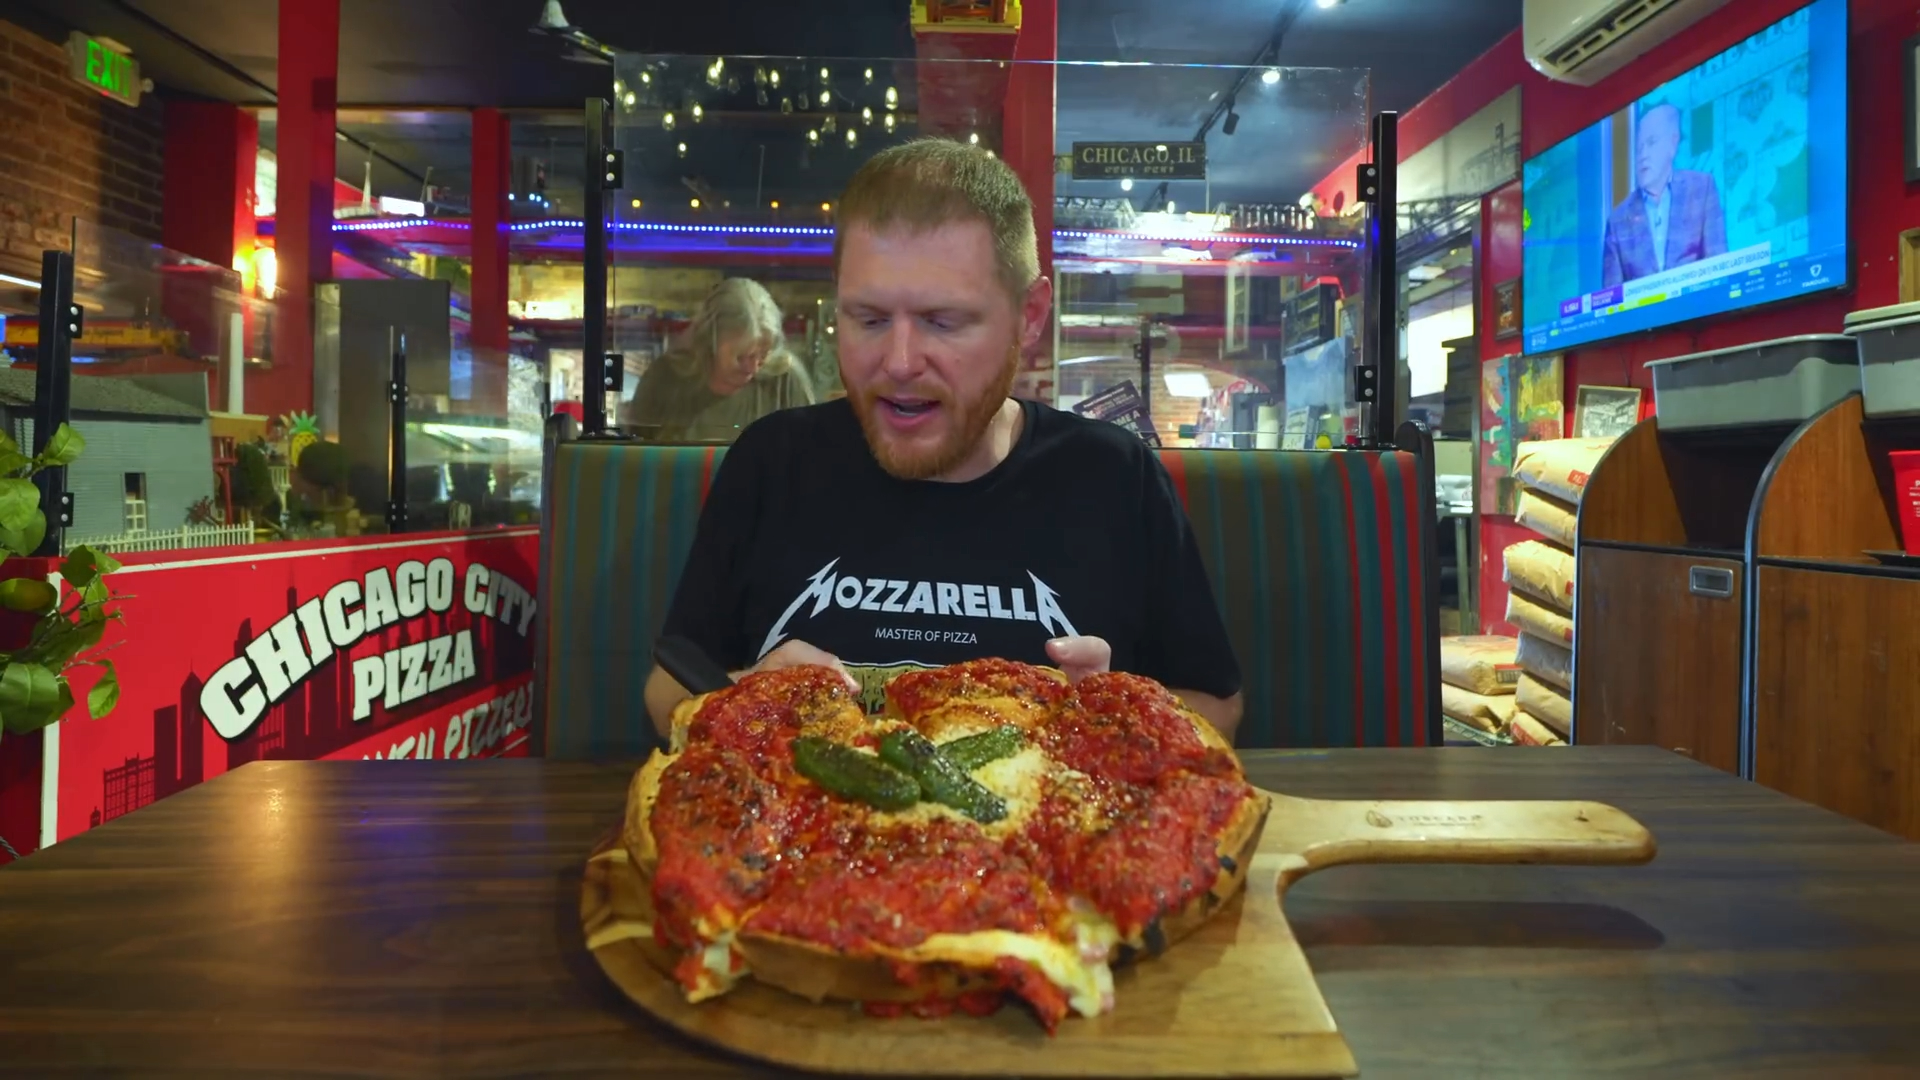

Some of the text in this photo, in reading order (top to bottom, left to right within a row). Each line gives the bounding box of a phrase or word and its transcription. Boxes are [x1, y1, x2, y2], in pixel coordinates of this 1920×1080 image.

[86, 40, 131, 98] EXIT
[1178, 147, 1196, 163] IL
[1564, 302, 1579, 314] LSU
[757, 556, 1083, 660] MOZZARELLA
[875, 627, 978, 645] MASTER OF PIZZA
[200, 557, 537, 739] CHICAGO CITY
[353, 630, 476, 721] PIZZA
